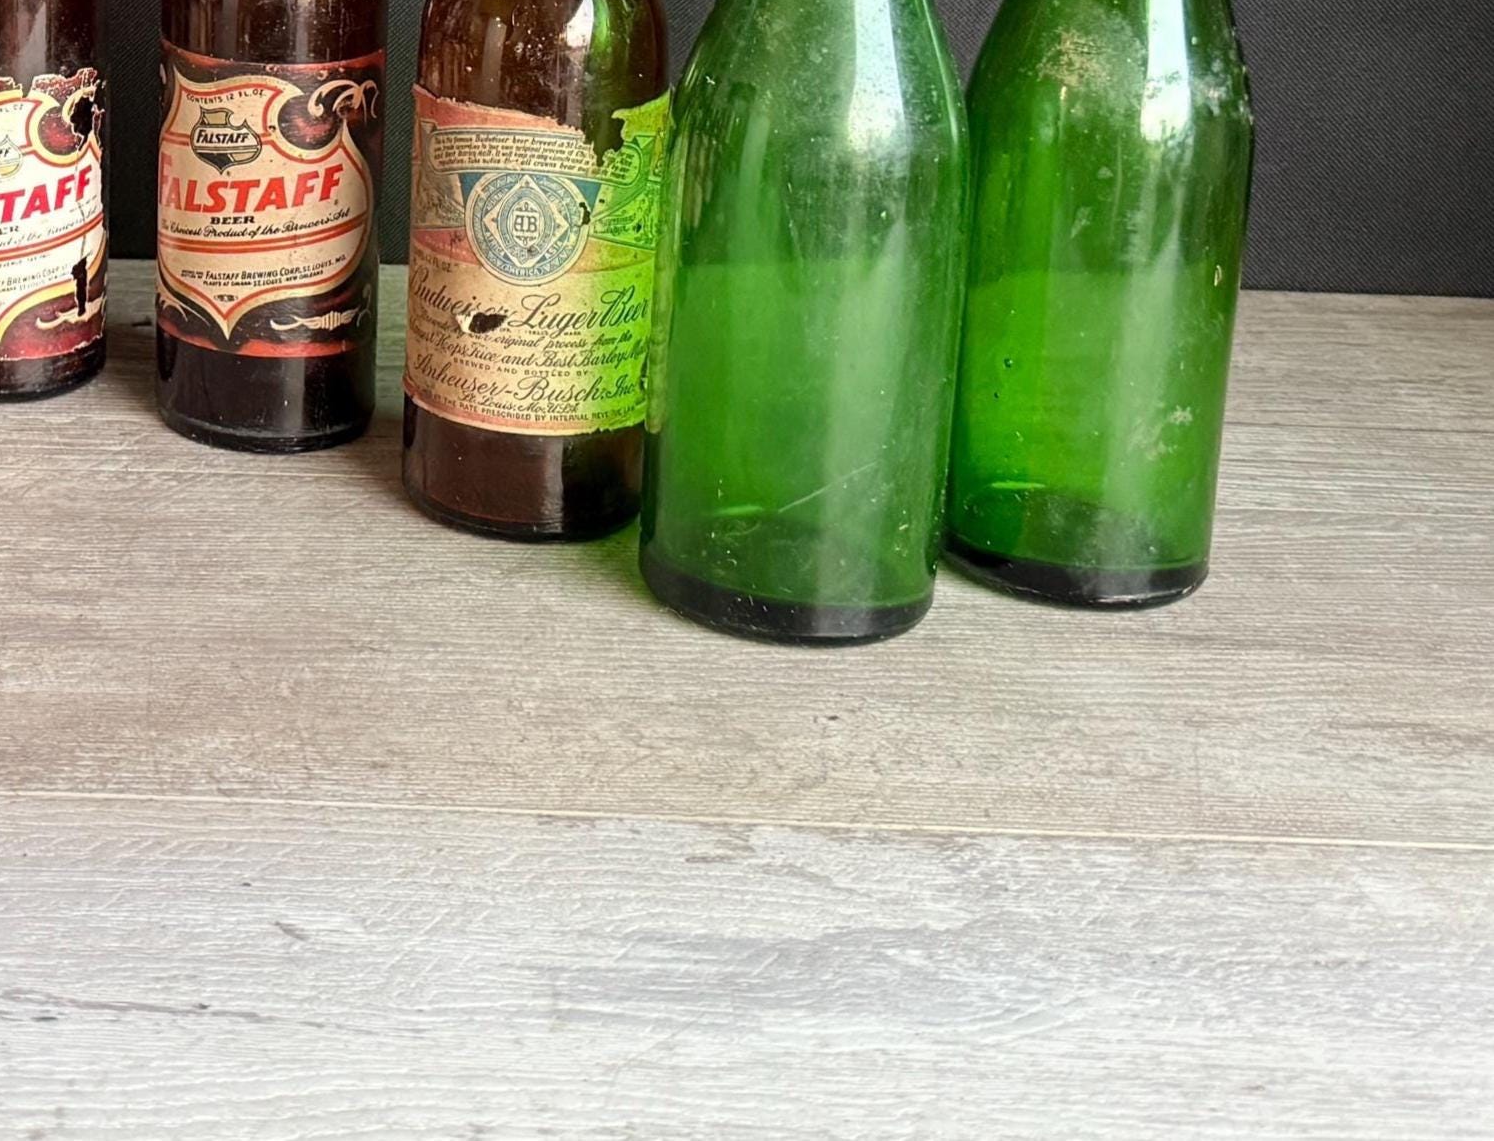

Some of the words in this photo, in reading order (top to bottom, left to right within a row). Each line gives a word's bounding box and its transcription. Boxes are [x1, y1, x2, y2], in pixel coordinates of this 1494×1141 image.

[186, 92, 223, 105] CONTENTS
[226, 93, 234, 101] 12
[196, 129, 250, 144] FALSTAFF
[159, 152, 344, 214] FALSTAFF
[210, 215, 255, 225] BEER
[170, 220, 202, 236] Choicest
[203, 225, 246, 238] Product
[260, 225, 280, 236] the
[205, 269, 240, 280] FALSTAFF
[241, 270, 278, 280] BREWING
[599, 285, 648, 327] Beer
[500, 352, 538, 367] and
[535, 349, 577, 368] Best
[453, 357, 491, 371] BREWED
[497, 366, 518, 376] AND
[523, 368, 571, 378] BOTTLED
[459, 403, 478, 414] RATE
